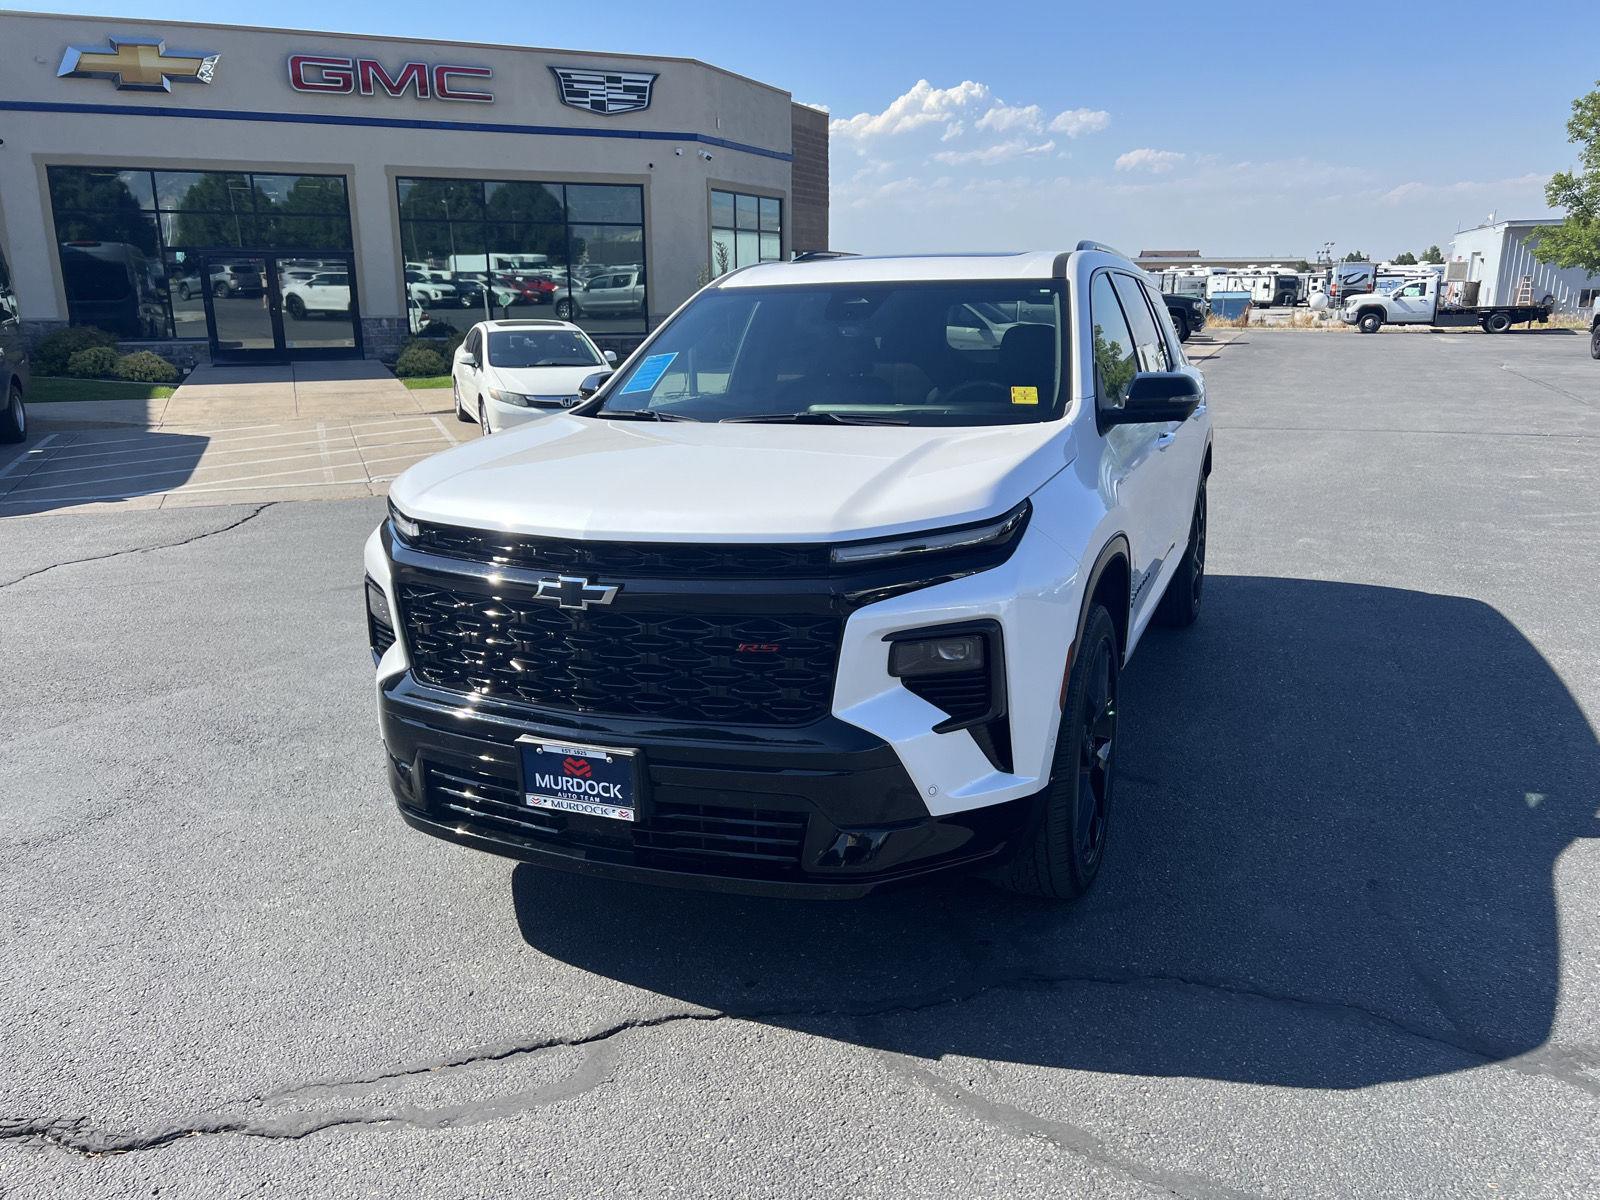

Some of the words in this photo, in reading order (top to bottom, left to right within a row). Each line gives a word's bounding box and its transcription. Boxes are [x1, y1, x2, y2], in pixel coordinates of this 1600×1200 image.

[288, 55, 494, 102] GMC
[535, 772, 623, 799] MURDOCK
[557, 791, 578, 800] AUTO
[580, 794, 600, 803] TEAM
[551, 800, 609, 816] MURDOCK
